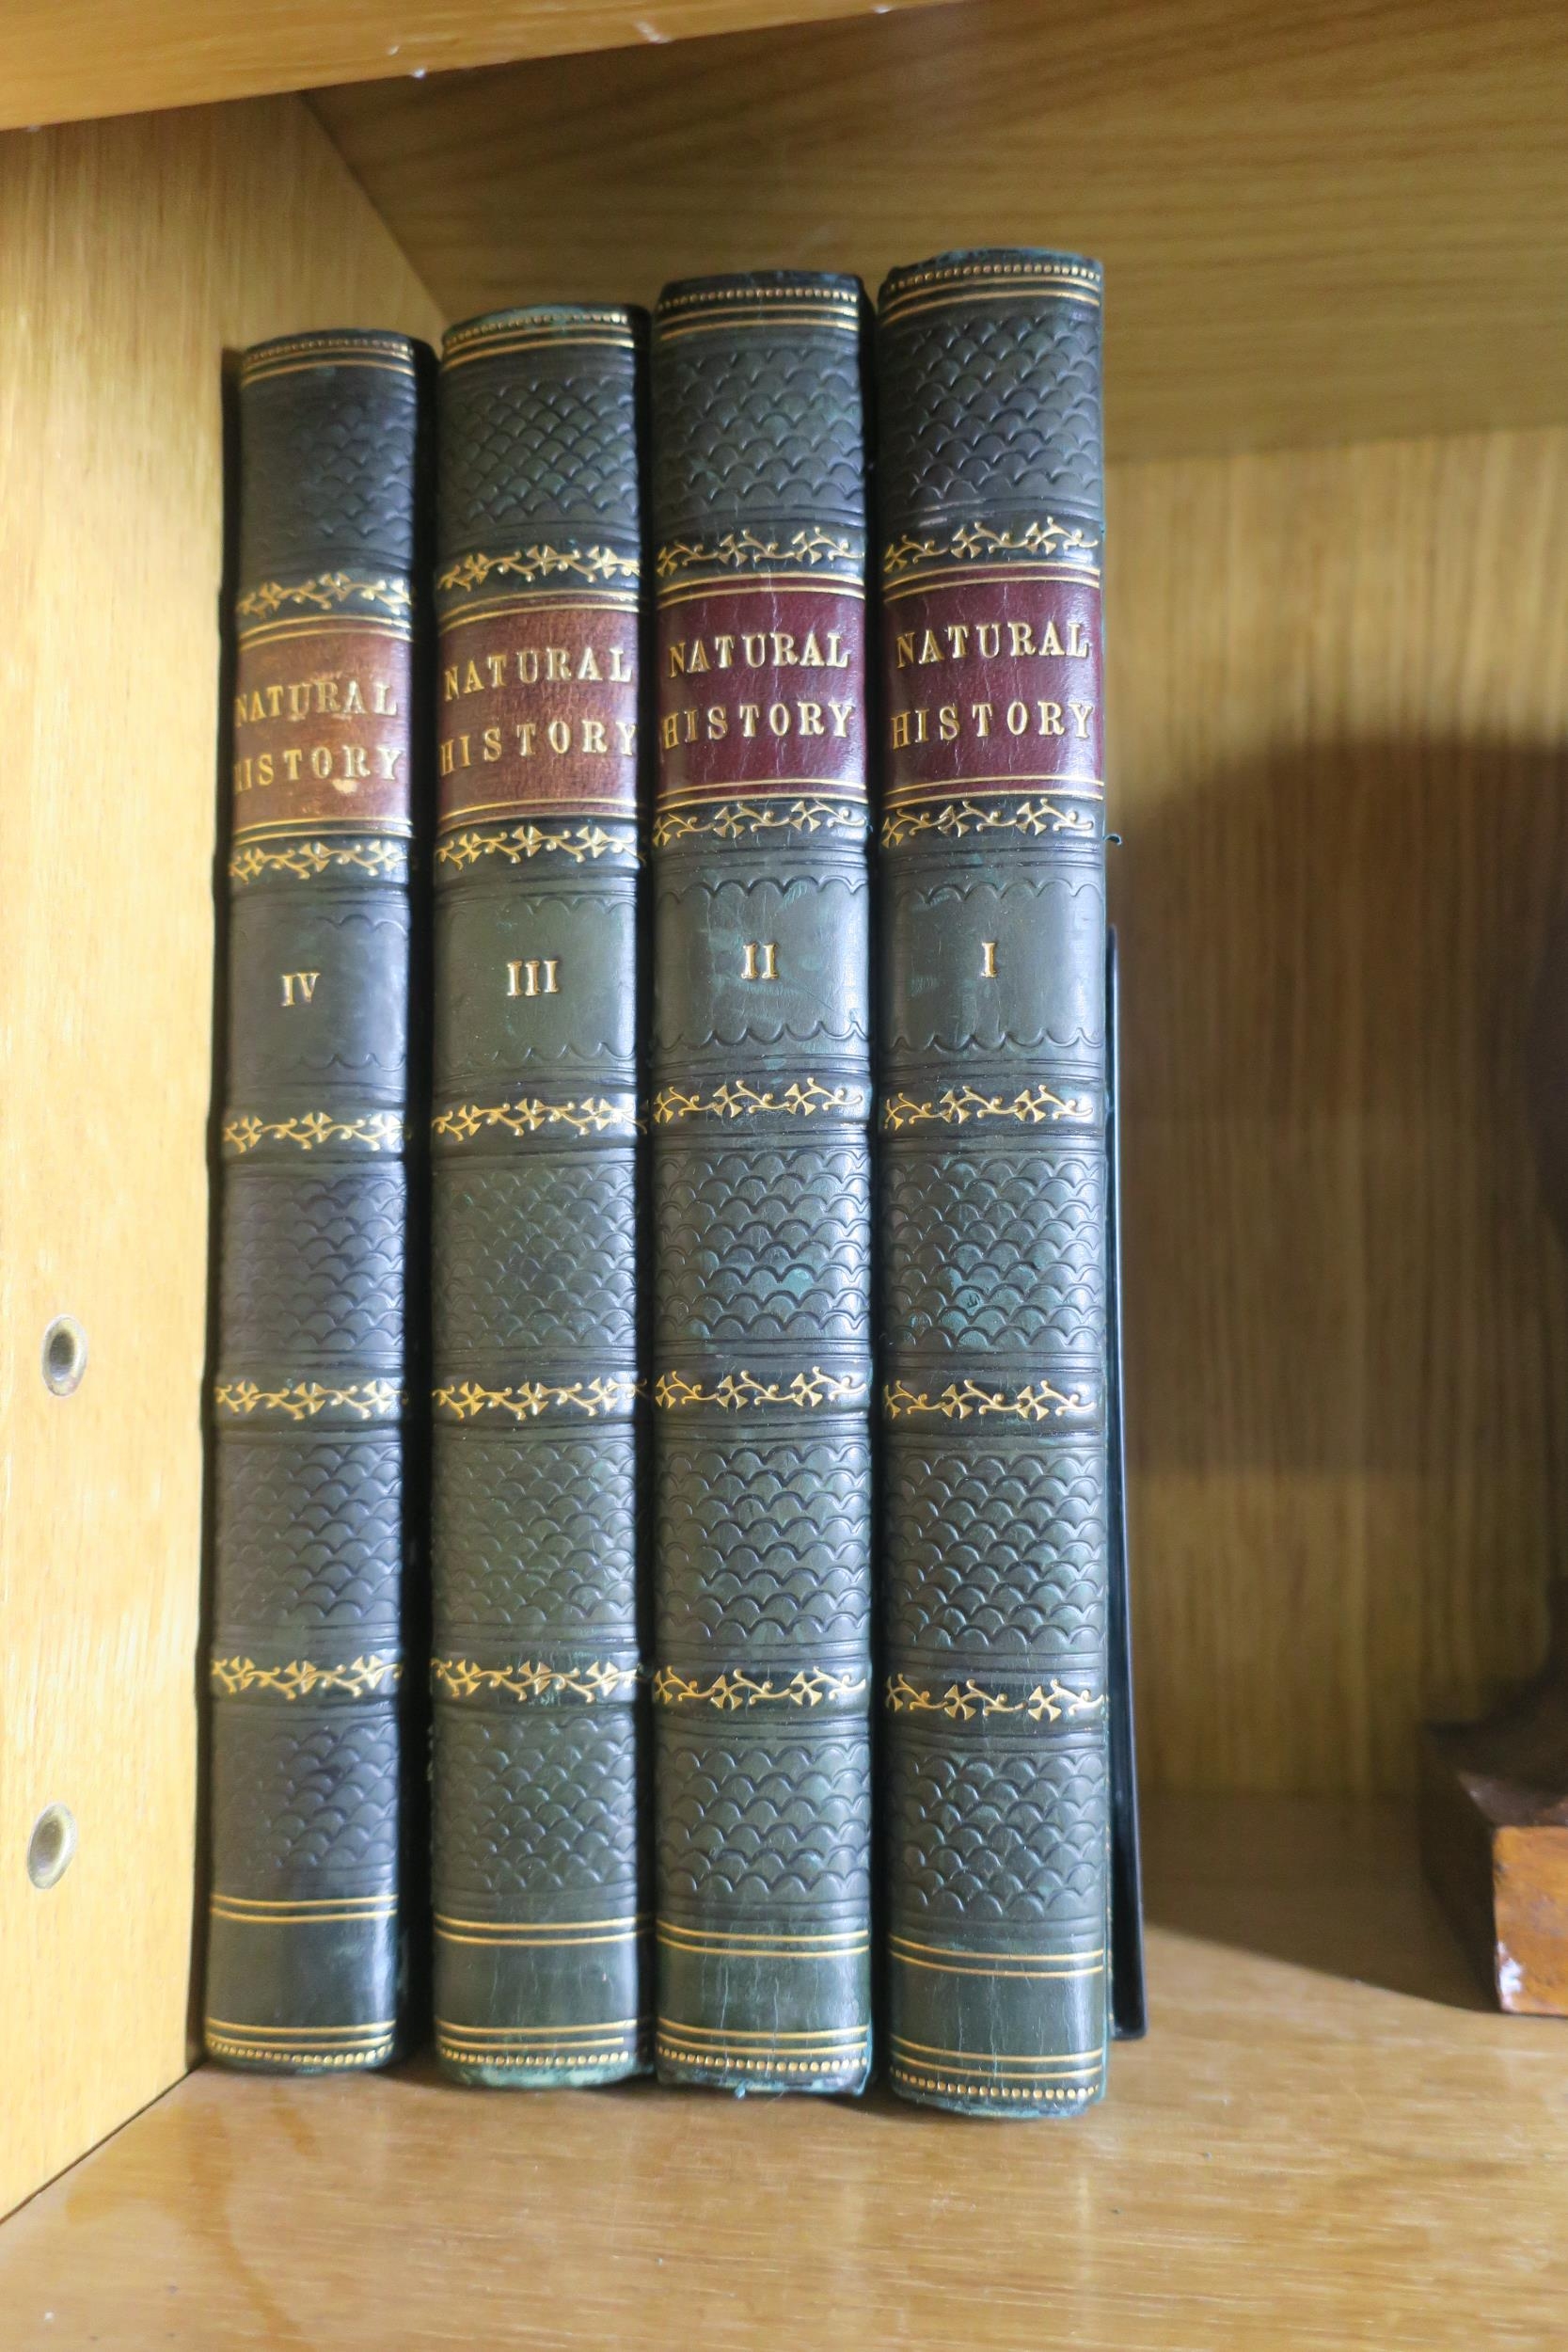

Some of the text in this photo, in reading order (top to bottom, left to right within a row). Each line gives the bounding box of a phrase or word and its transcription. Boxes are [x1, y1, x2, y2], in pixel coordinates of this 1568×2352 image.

[668, 632, 850, 678] NATURAL
[895, 620, 1092, 670] NATURAL
[443, 646, 633, 701] NATURAL
[234, 680, 399, 728] NATURAL
[661, 701, 855, 751] HISTORY
[891, 700, 1095, 751] HISTORY
[232, 744, 404, 796] HISTORY
[439, 721, 638, 777] HISTORY
[506, 959, 561, 997] III
[741, 941, 779, 980] II
[980, 942, 999, 978] I
[281, 971, 321, 1007] IV
